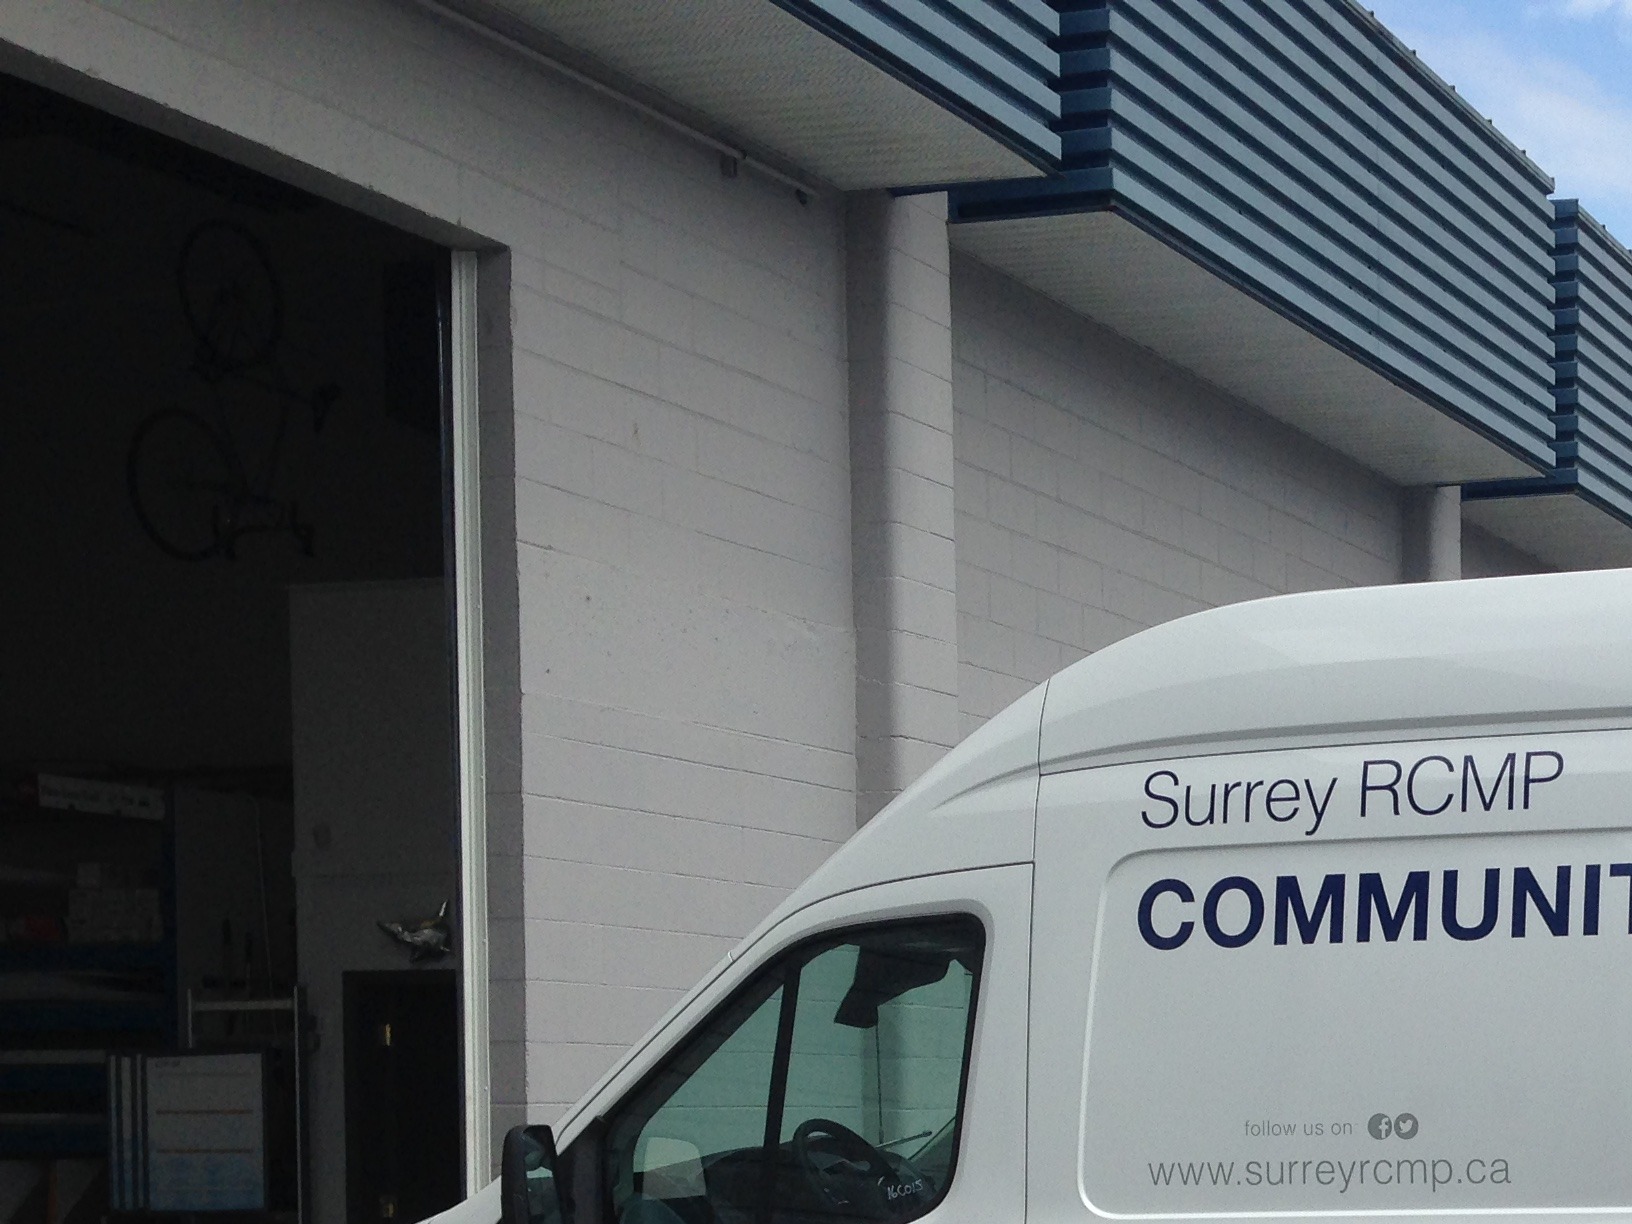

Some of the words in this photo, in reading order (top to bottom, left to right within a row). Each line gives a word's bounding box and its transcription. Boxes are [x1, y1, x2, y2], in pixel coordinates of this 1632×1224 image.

[1140, 770, 1338, 837] Surrey
[1359, 750, 1565, 818] RCMP
[1245, 1120, 1296, 1137] follow
[1303, 1122, 1324, 1136] us
[1331, 1121, 1353, 1136] on
[1148, 1158, 1512, 1193] www.surreyrcmp.ca
